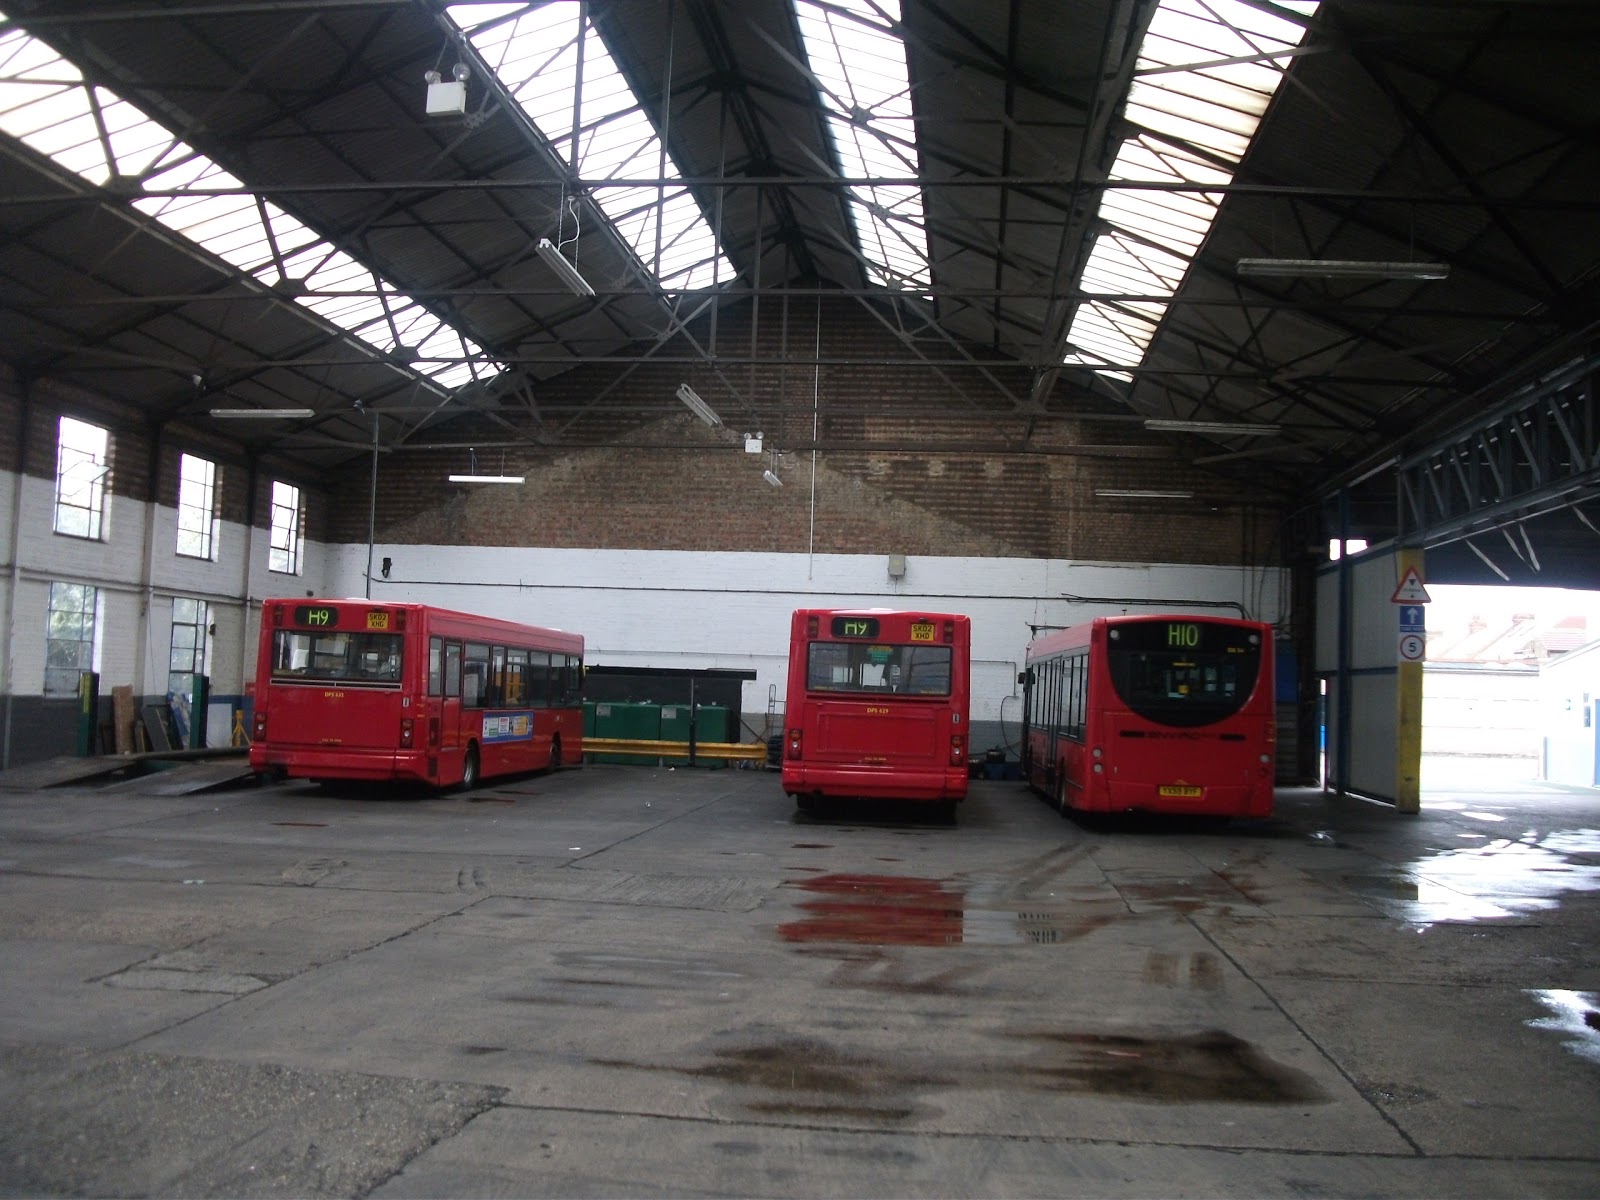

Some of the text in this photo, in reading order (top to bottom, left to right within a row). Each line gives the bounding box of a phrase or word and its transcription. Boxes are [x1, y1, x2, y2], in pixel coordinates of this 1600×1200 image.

[308, 609, 329, 625] H9
[1168, 624, 1198, 646] H10
[1408, 642, 1417, 652] 5
